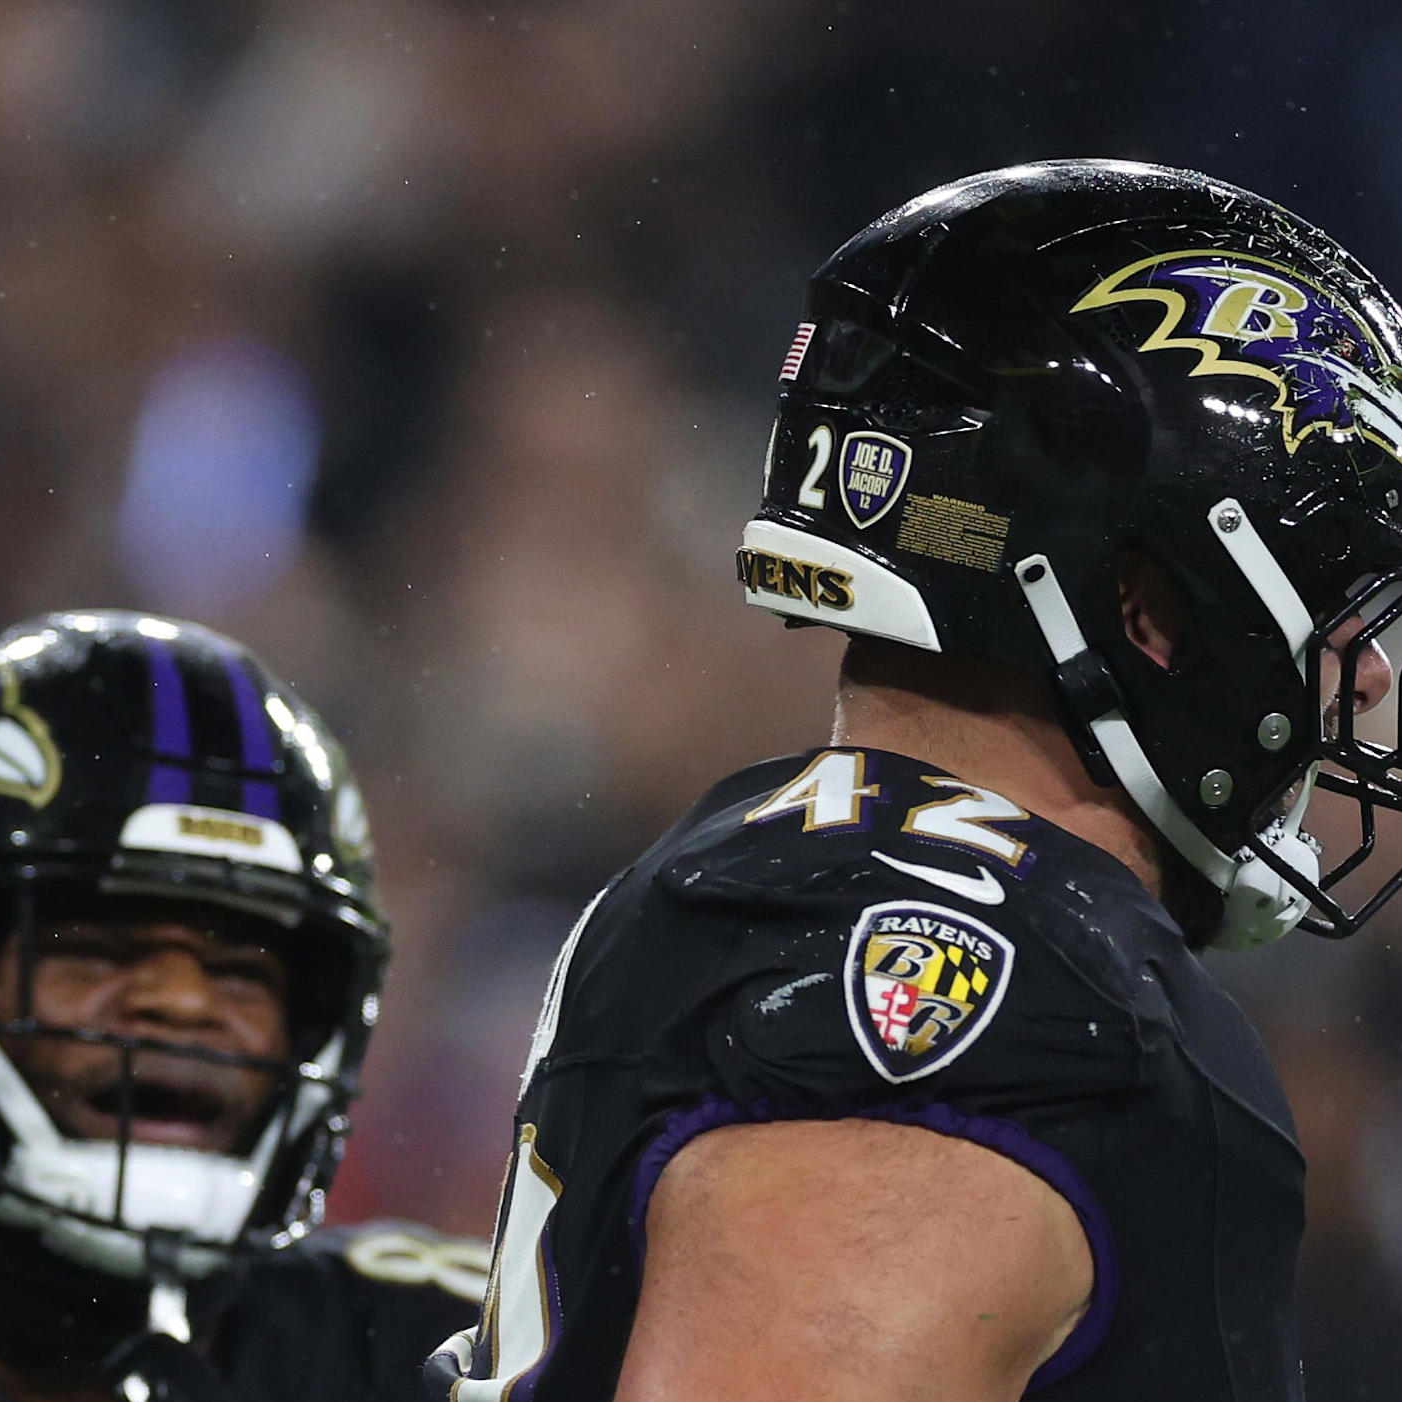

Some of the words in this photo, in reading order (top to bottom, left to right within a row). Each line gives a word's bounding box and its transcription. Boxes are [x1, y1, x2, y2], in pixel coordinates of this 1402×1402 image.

[1169, 265, 1309, 343] B
[851, 441, 880, 471] JOE
[878, 447, 894, 475] D.
[847, 470, 891, 498] JACOBY
[859, 493, 871, 509] 12
[932, 493, 986, 512] WARNING
[736, 546, 855, 611] VENS
[743, 751, 1031, 868] 42
[877, 916, 993, 961] RAVENS
